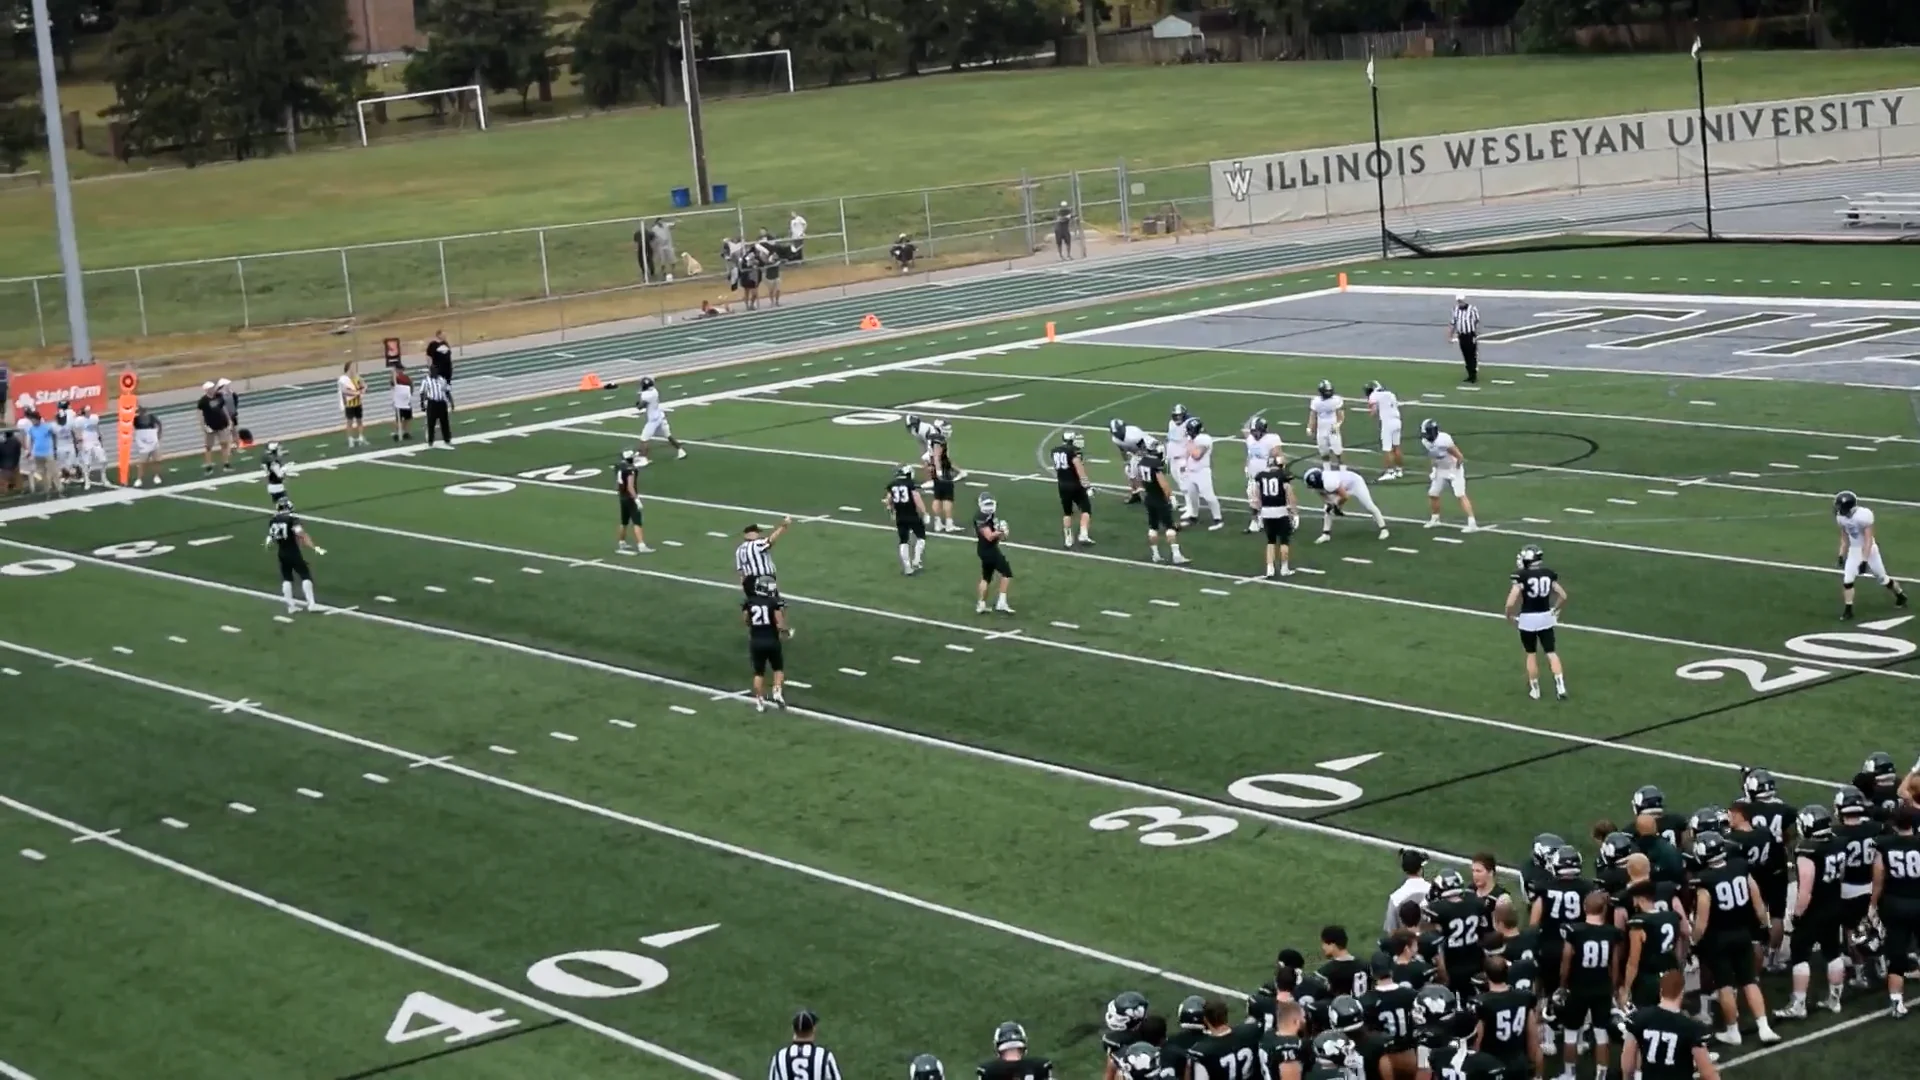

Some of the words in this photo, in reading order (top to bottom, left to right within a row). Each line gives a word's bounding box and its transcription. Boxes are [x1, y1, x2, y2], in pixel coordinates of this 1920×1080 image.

[1265, 145, 1426, 191] ILLINOIS
[1444, 121, 1646, 169] WESLEYAN
[1667, 95, 1904, 147] UNIVERSITY
[1476, 305, 1920, 366] TIT
[891, 485, 910, 504] 33
[1262, 477, 1281, 497] 10
[1527, 576, 1551, 598] 30
[751, 605, 771, 625] 21
[1676, 632, 1918, 693] 20
[1089, 773, 1364, 847] 30
[1846, 837, 1876, 867] 26
[1888, 849, 1920, 878] 58
[1547, 889, 1581, 919] 79
[1715, 875, 1750, 911] 90
[1448, 915, 1479, 948] 22
[1582, 940, 1610, 968] 81
[385, 949, 669, 1044] 40
[1496, 1006, 1527, 1042] 54
[1643, 1028, 1678, 1066] 77
[791, 1057, 810, 1080] S
